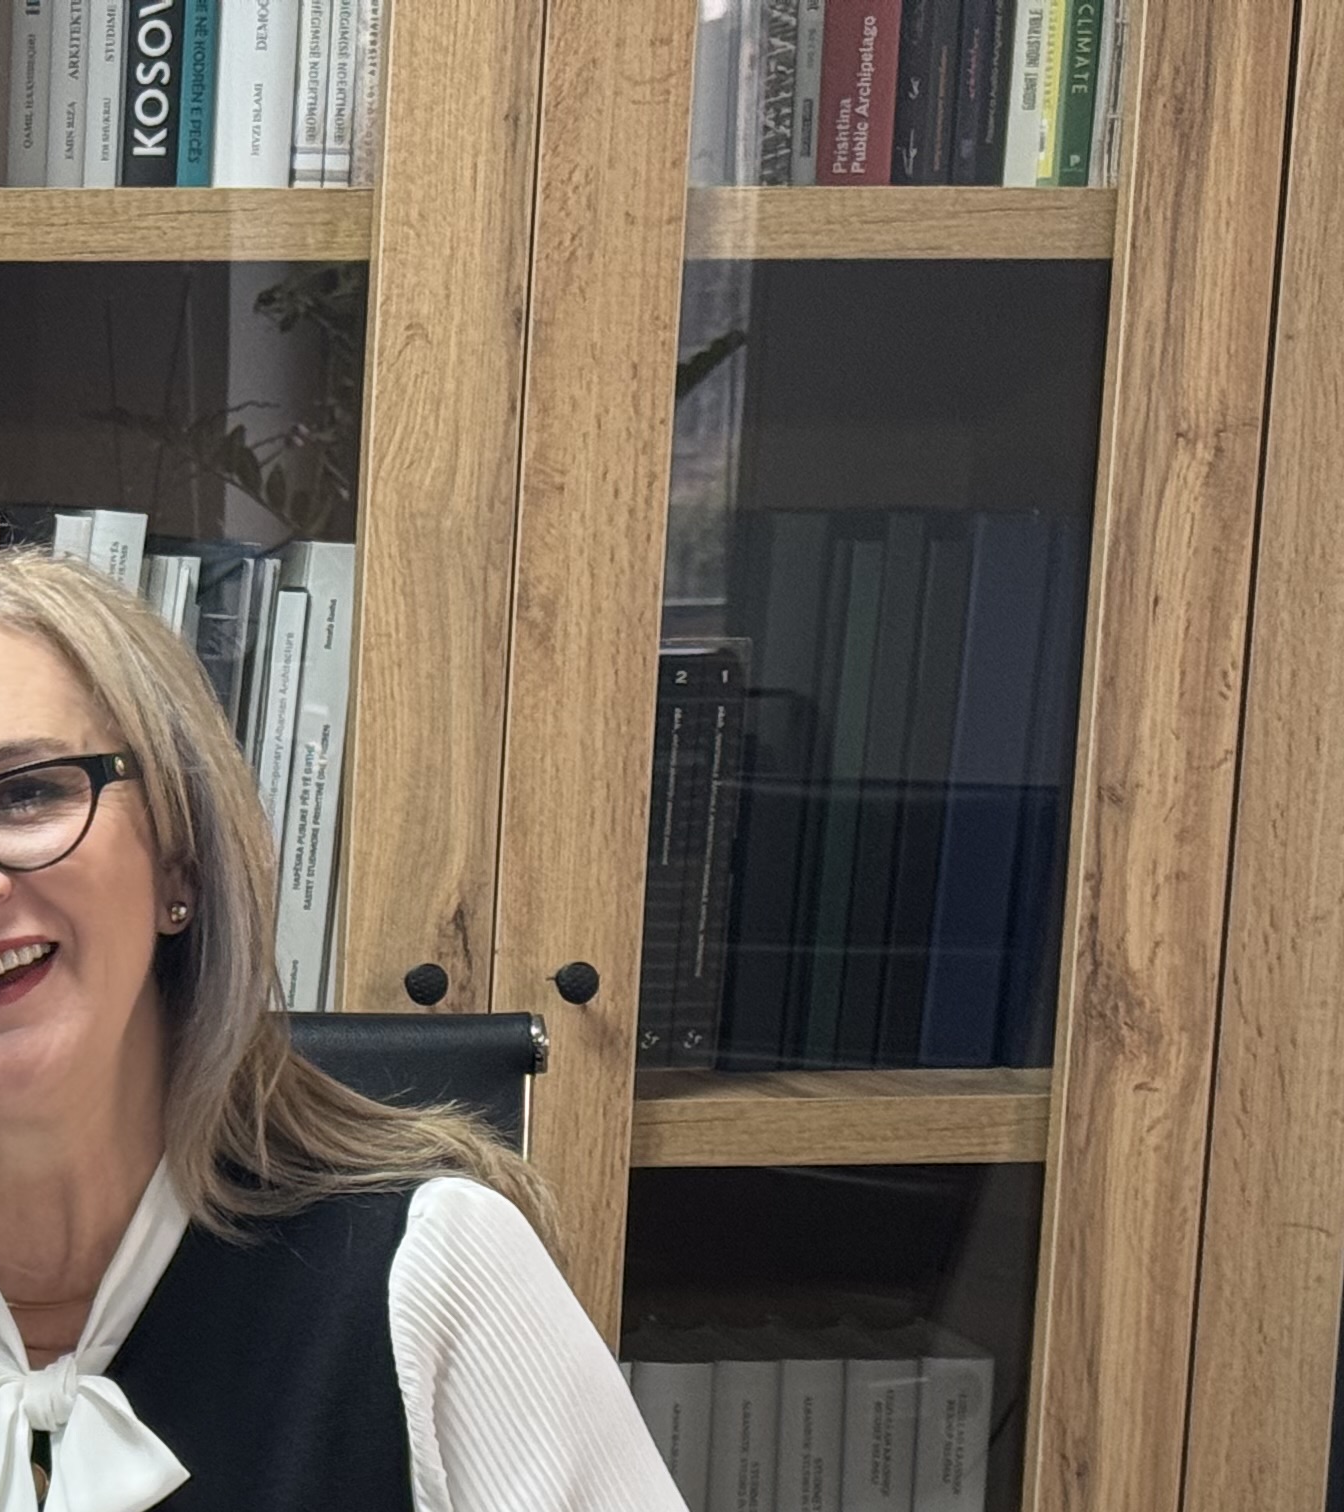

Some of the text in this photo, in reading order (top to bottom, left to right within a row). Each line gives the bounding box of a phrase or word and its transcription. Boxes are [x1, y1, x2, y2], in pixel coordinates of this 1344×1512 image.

[1071, 3, 1095, 95] CLIMATE
[851, 15, 879, 174] Public Archipelago
[832, 97, 852, 174] Prishtina
[277, 631, 295, 696] Architecture
[674, 669, 688, 685] 2
[721, 669, 730, 685] 1
